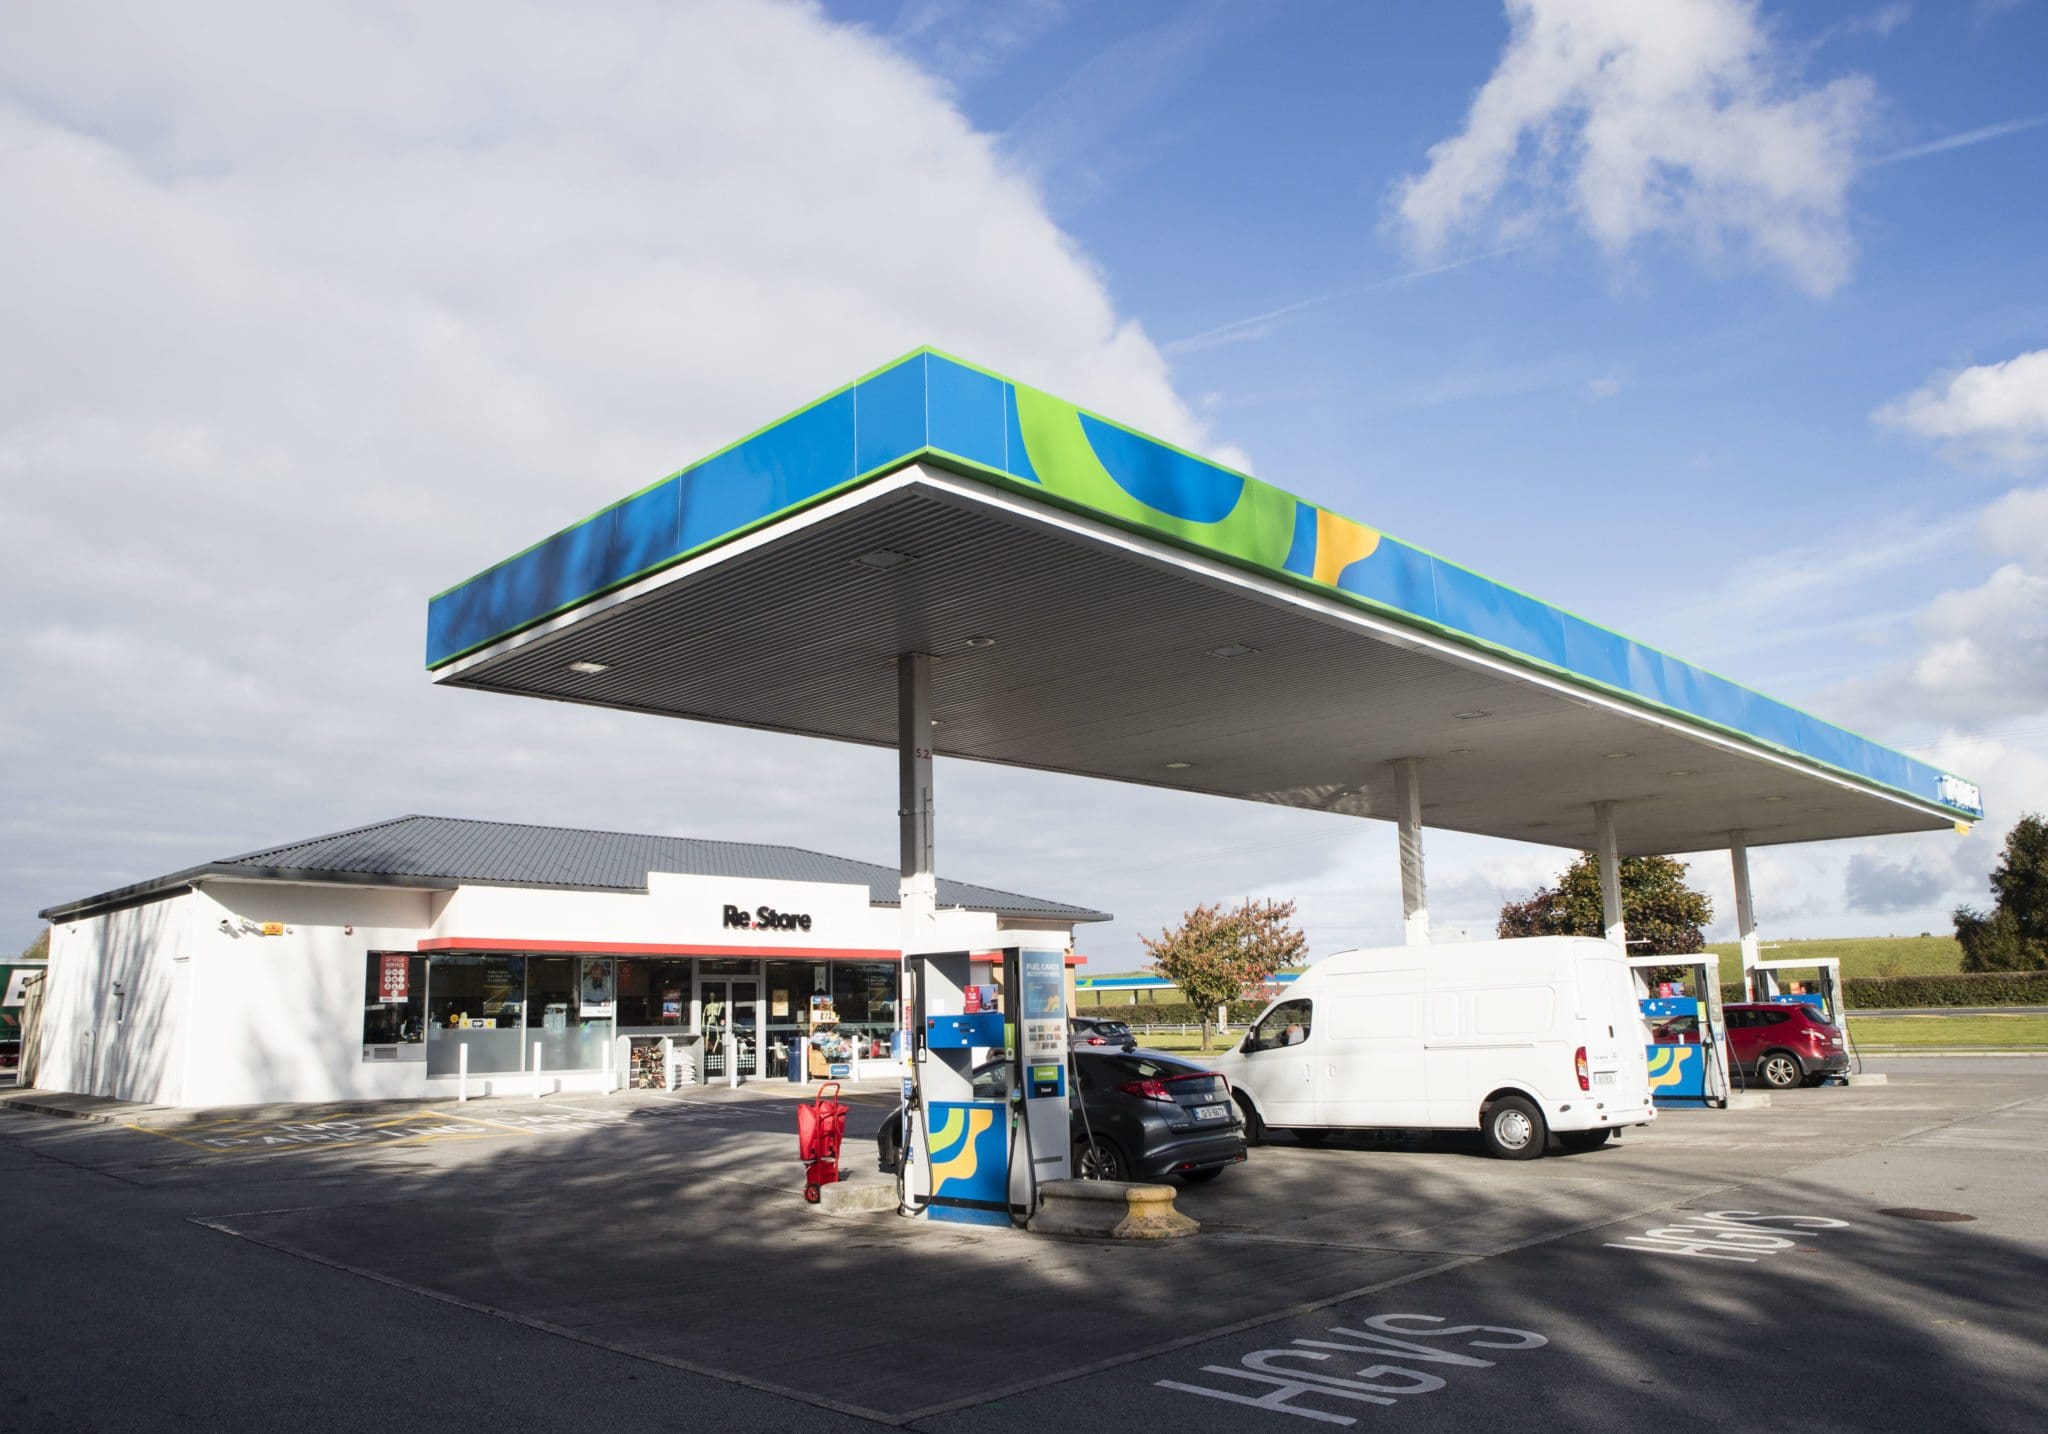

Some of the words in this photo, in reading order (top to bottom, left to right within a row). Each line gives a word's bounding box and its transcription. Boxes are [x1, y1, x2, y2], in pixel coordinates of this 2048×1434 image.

[1649, 1002, 1657, 1012] 4
[275, 1121, 361, 1133] NO
[1602, 1210, 1850, 1263] HGVS
[1153, 1313, 1549, 1426] HGVS
